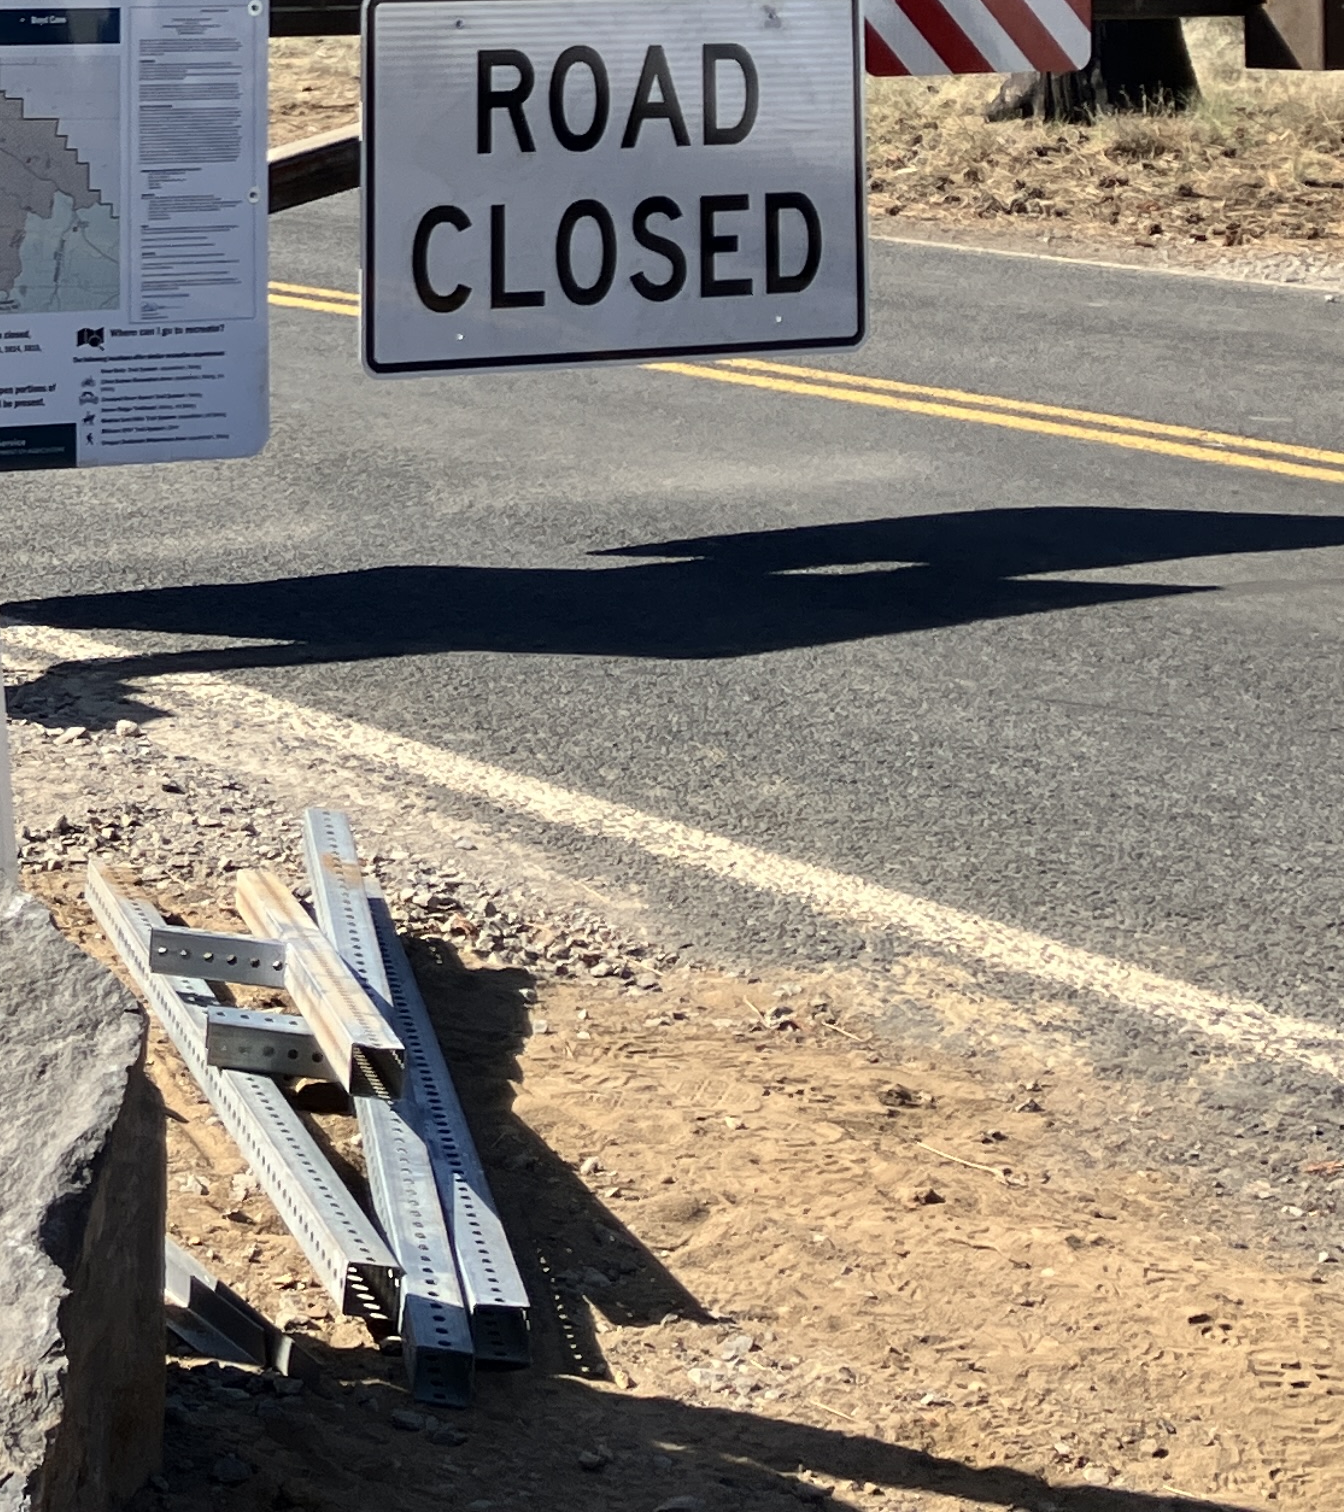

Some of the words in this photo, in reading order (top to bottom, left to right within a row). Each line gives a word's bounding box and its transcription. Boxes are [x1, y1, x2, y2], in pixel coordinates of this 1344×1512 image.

[475, 42, 760, 155] ROAD
[411, 191, 822, 314] CLOSED
[3, 400, 12, 408] be
[15, 385, 46, 395] portions
[49, 383, 57, 392] of
